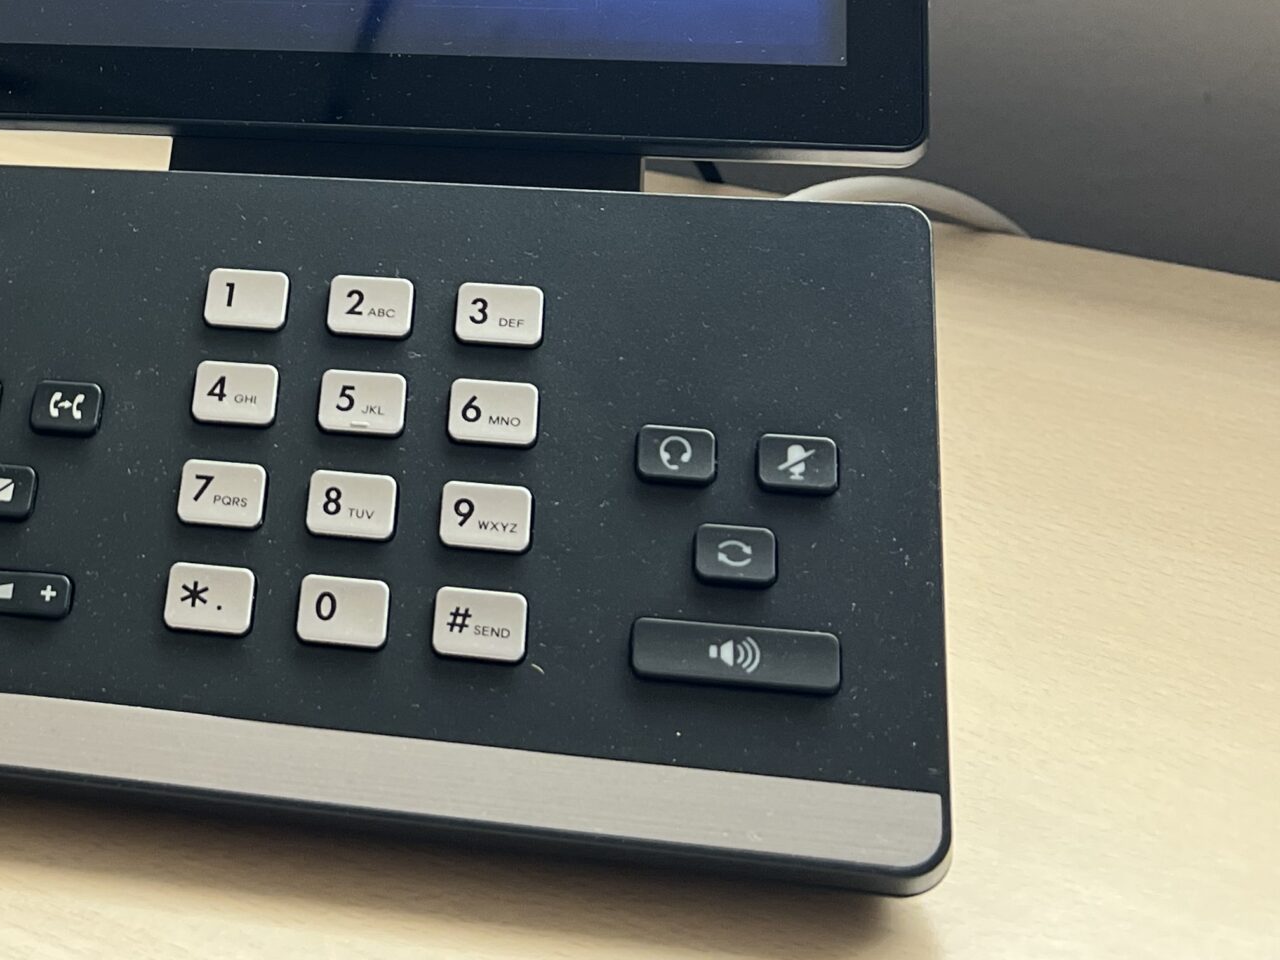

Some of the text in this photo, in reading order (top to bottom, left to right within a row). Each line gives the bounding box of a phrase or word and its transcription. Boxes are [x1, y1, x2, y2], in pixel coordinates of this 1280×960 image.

[225, 283, 235, 307] 1
[346, 289, 396, 318] 2 ABC
[469, 298, 525, 328] 3 DEF
[206, 376, 257, 405] 4 GHI
[336, 385, 384, 416] 5 JKL
[461, 396, 521, 427] 6 MNO
[193, 474, 248, 508] 7 PQRS
[322, 487, 375, 520] 8 TUV
[454, 498, 518, 533] 9 WXYZ
[315, 591, 337, 621] 0
[473, 625, 511, 638] SEND
